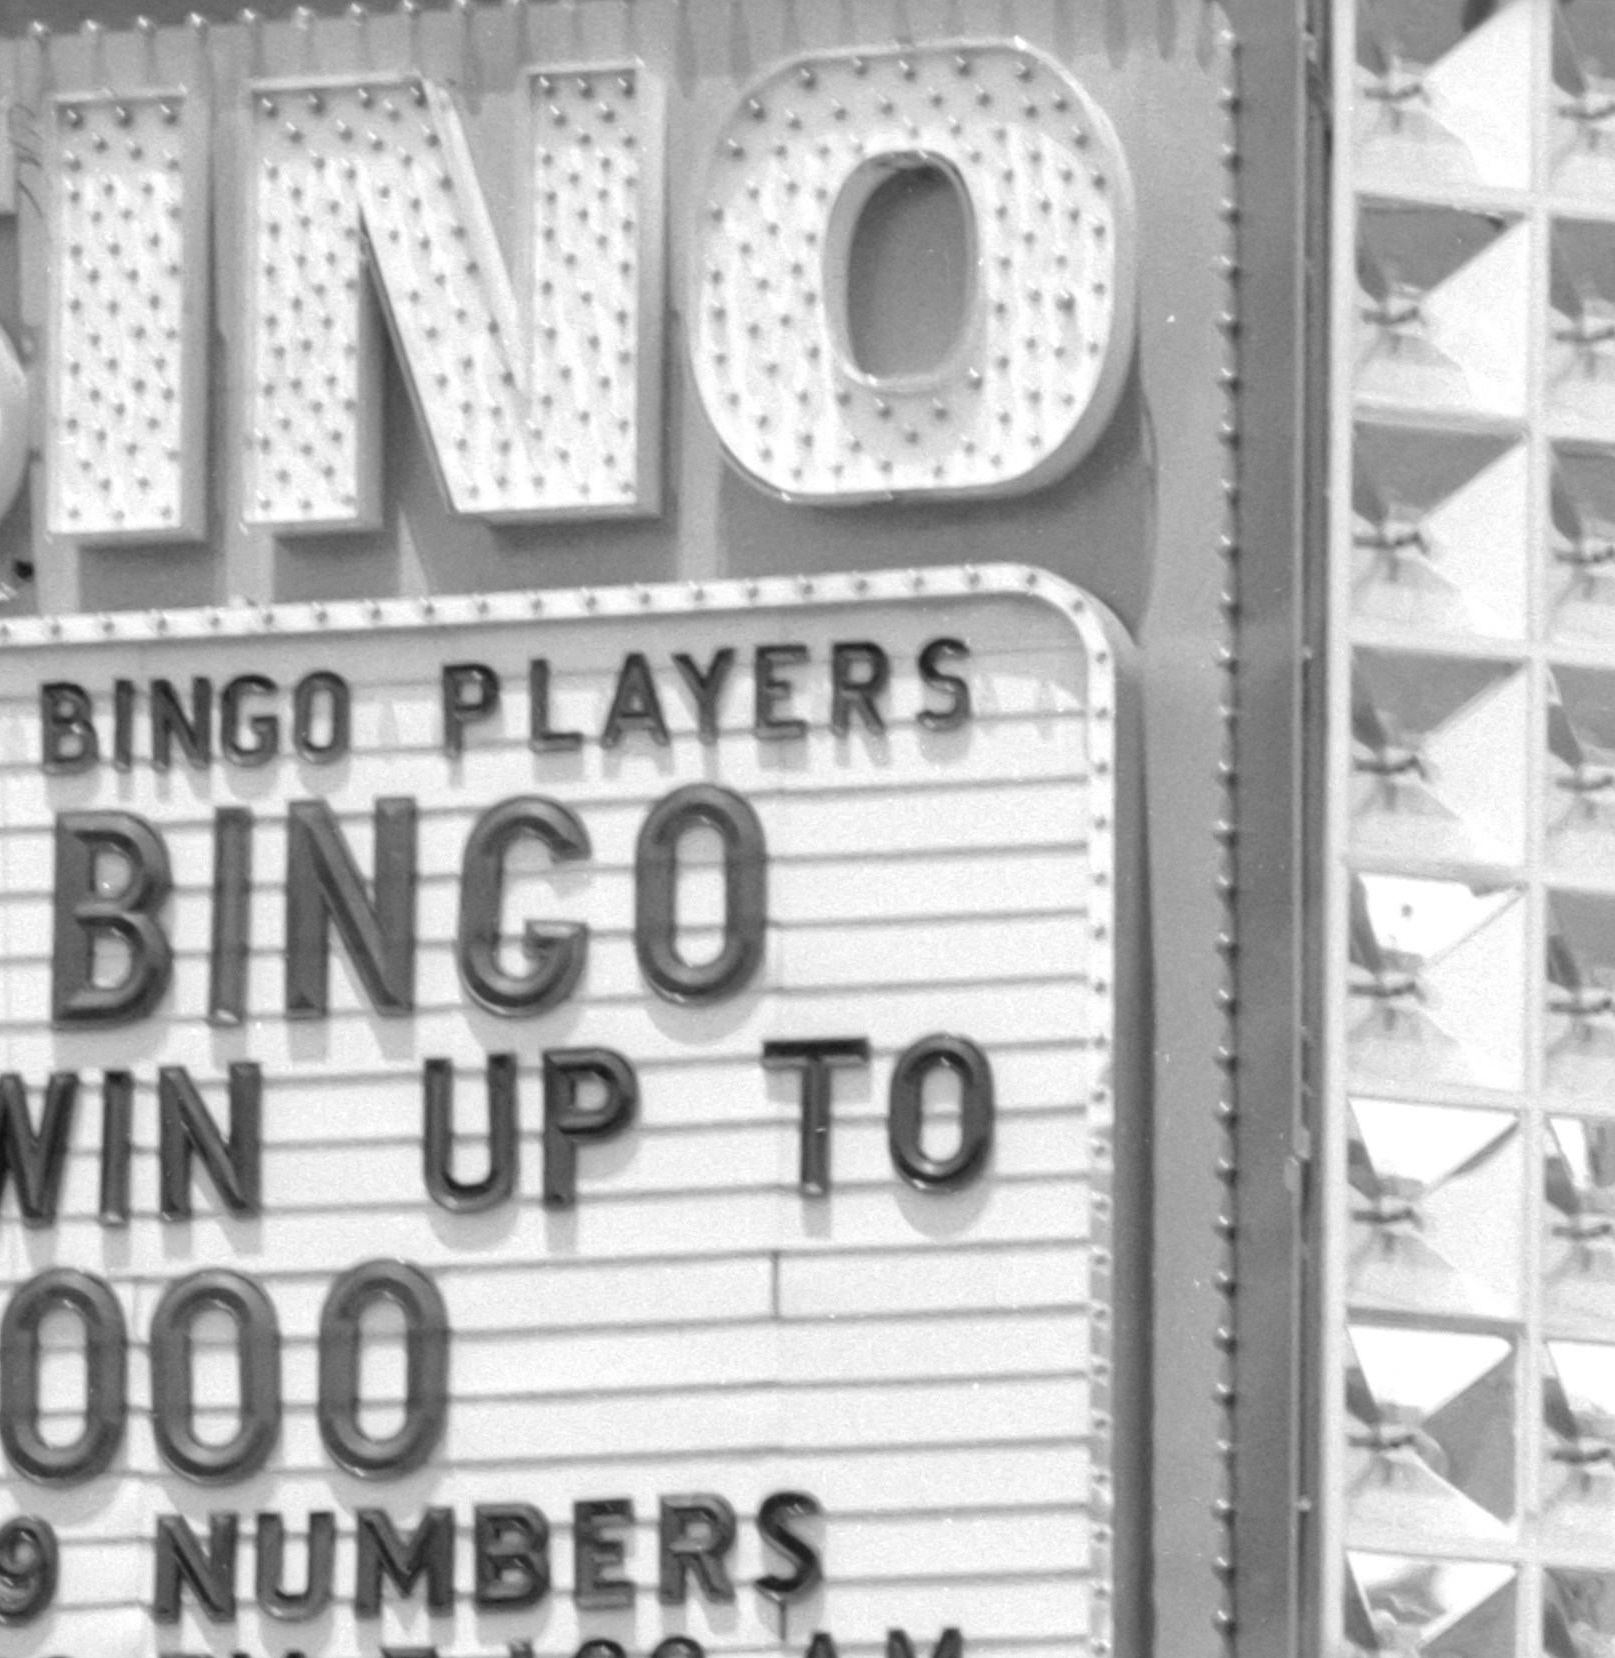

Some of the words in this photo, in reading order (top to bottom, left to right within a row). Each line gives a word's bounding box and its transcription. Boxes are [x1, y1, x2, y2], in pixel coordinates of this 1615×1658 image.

[37, 668, 353, 778] BINGO
[438, 635, 972, 756] PLAYERS
[49, 786, 771, 1035] BINGO
[419, 1045, 641, 1217] UP
[759, 1034, 998, 1201] TO
[149, 1489, 826, 1627] NUMBERS
